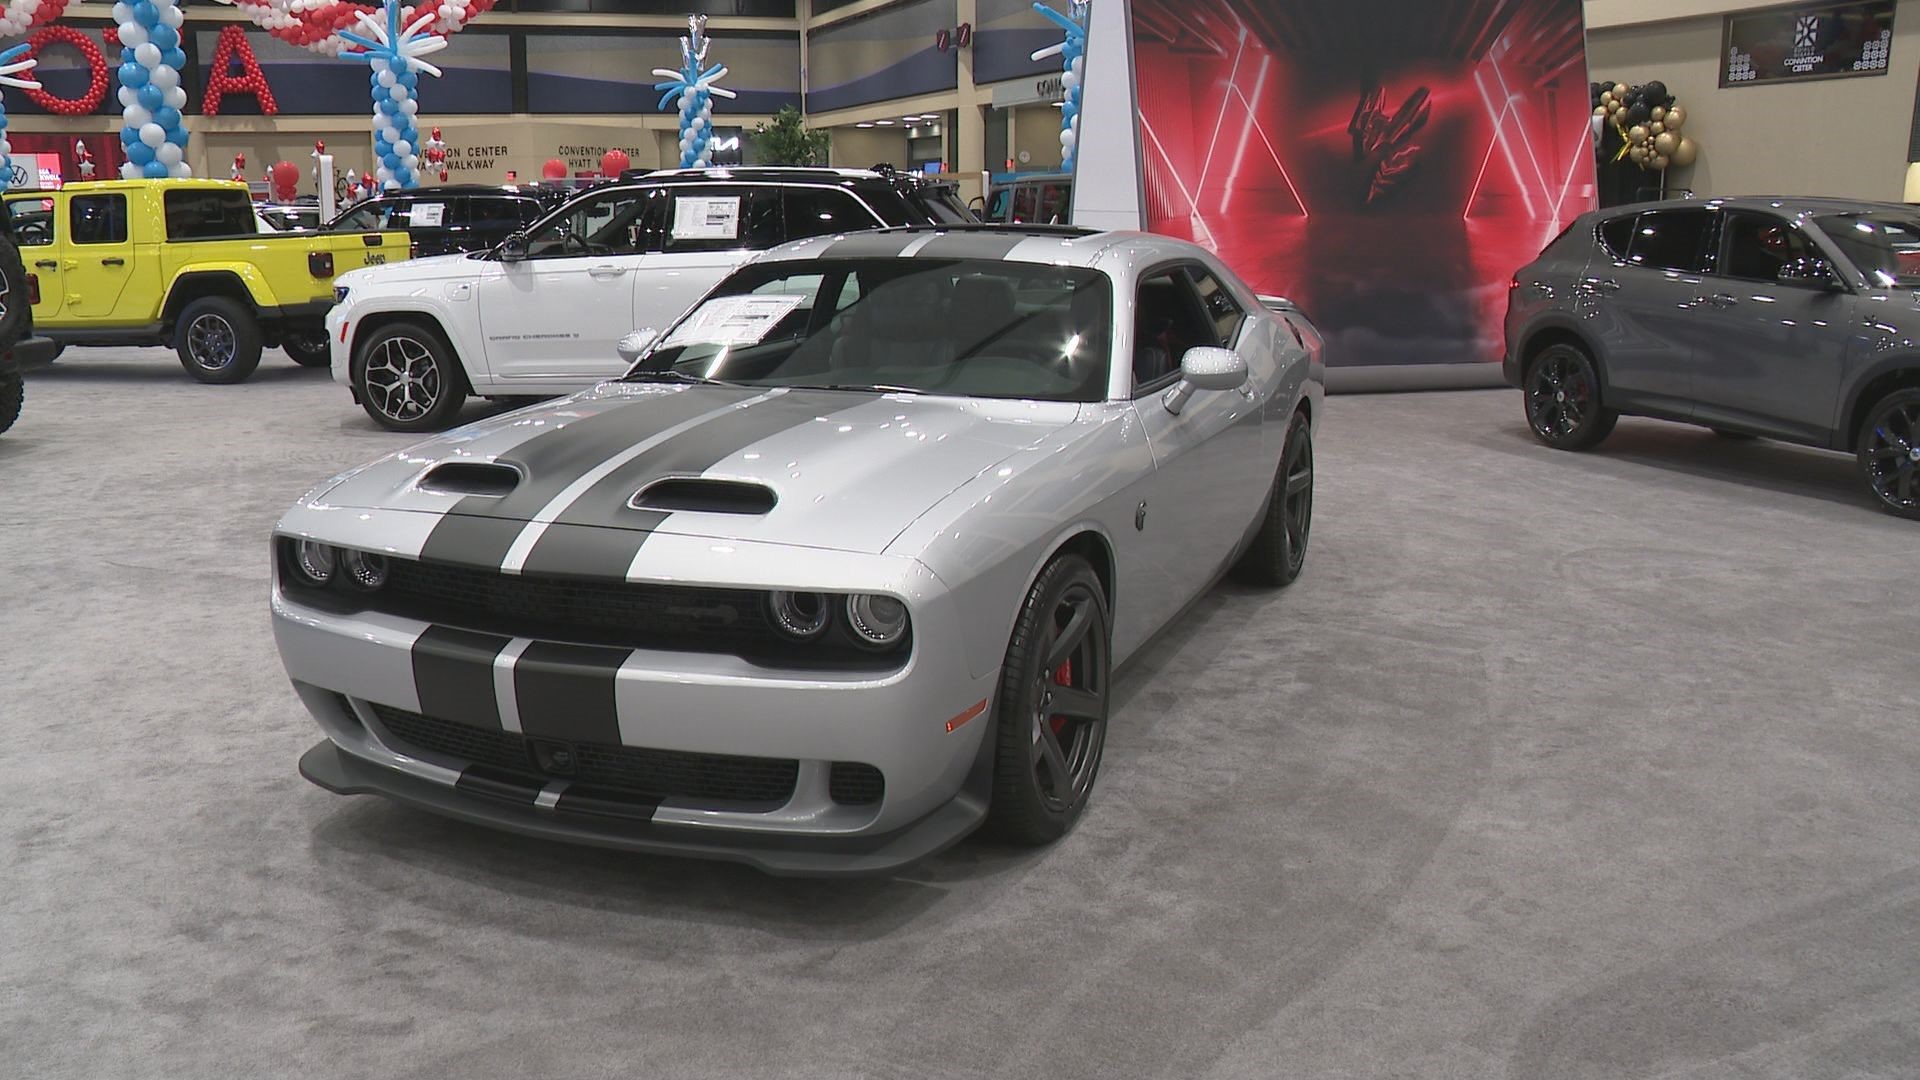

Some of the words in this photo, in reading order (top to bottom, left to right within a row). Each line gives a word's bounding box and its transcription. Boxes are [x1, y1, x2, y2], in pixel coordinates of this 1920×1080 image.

[467, 146, 508, 158] CENTER
[558, 146, 607, 156] CONVENTION
[445, 159, 495, 171] WALKWAY
[568, 158, 591, 168] HYATT
